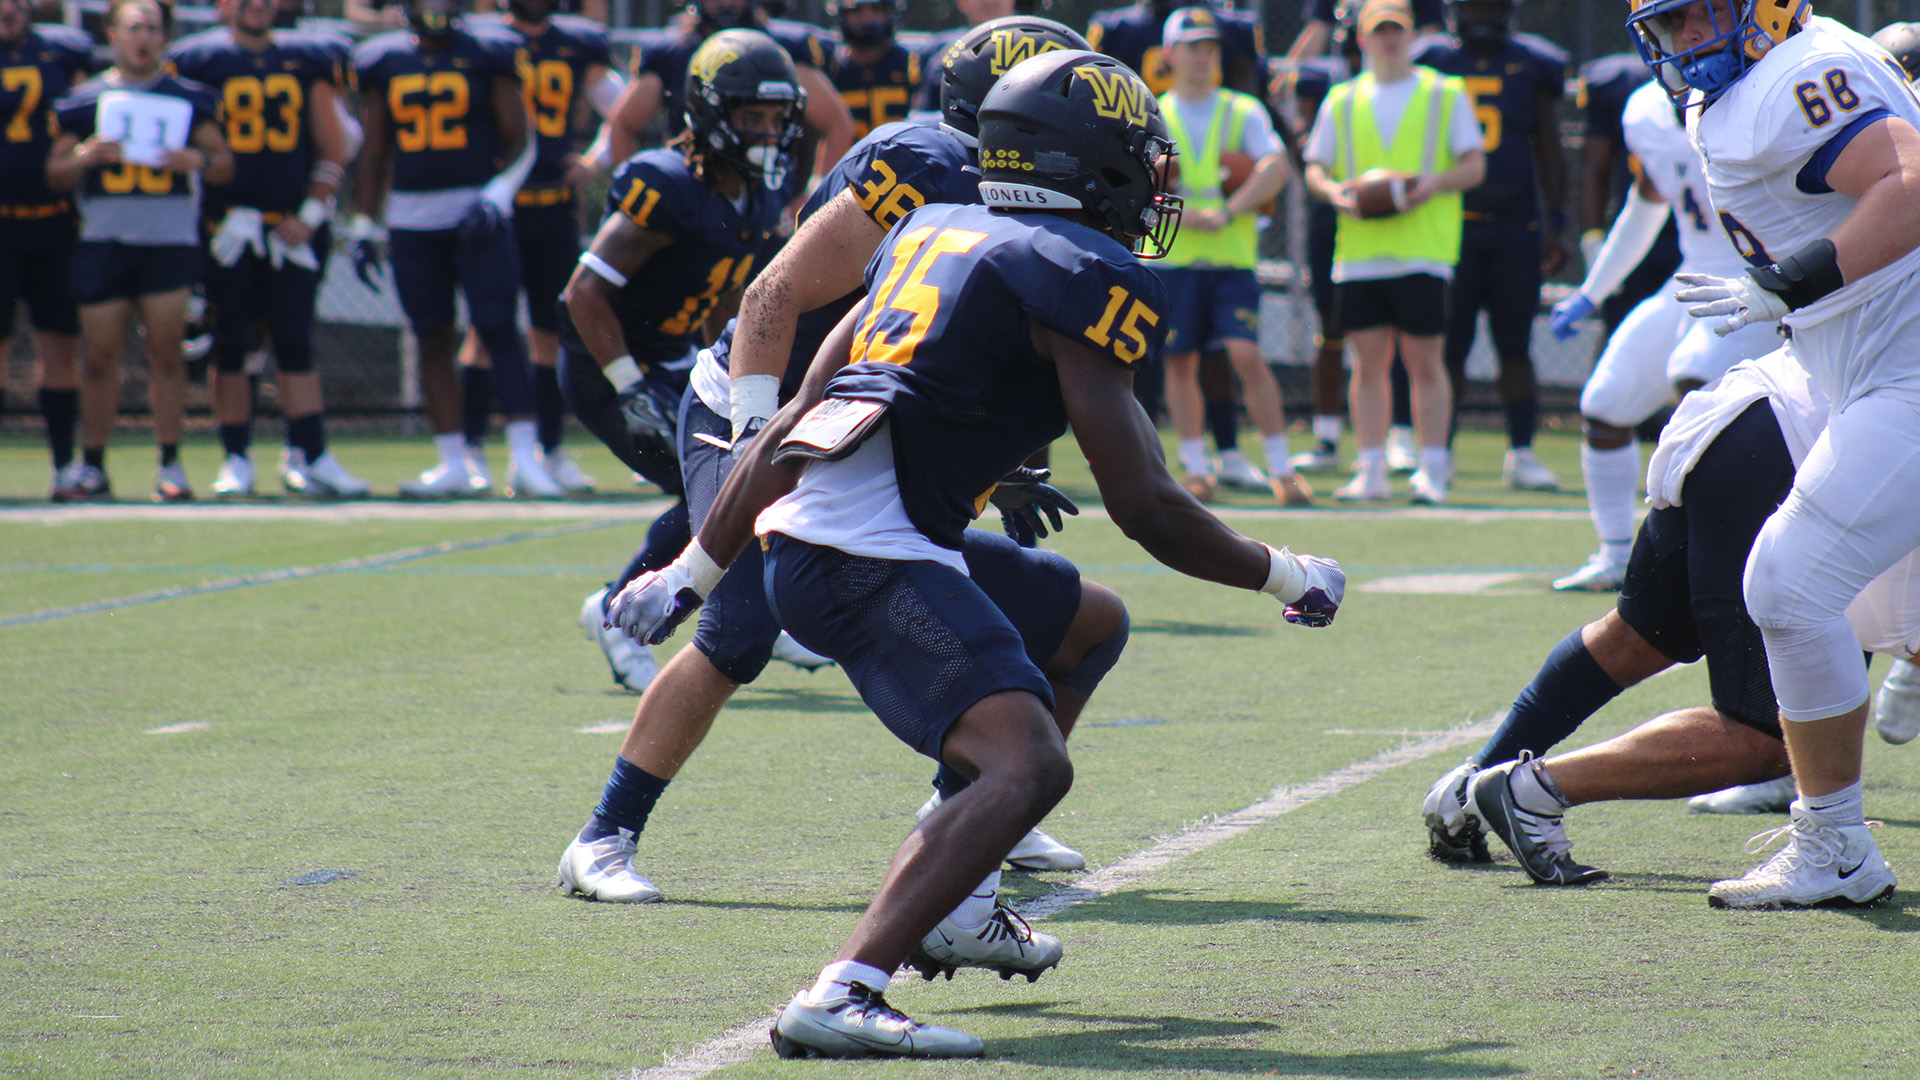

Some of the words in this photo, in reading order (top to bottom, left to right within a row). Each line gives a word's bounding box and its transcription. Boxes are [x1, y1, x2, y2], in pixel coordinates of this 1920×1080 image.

[2, 66, 42, 142] 7
[223, 74, 303, 152] 83
[388, 72, 470, 152] 52
[1073, 67, 1149, 128] W
[1793, 67, 1861, 129] 68
[619, 178, 661, 227] 11
[850, 226, 989, 366] 15
[1083, 285, 1160, 364] 15
